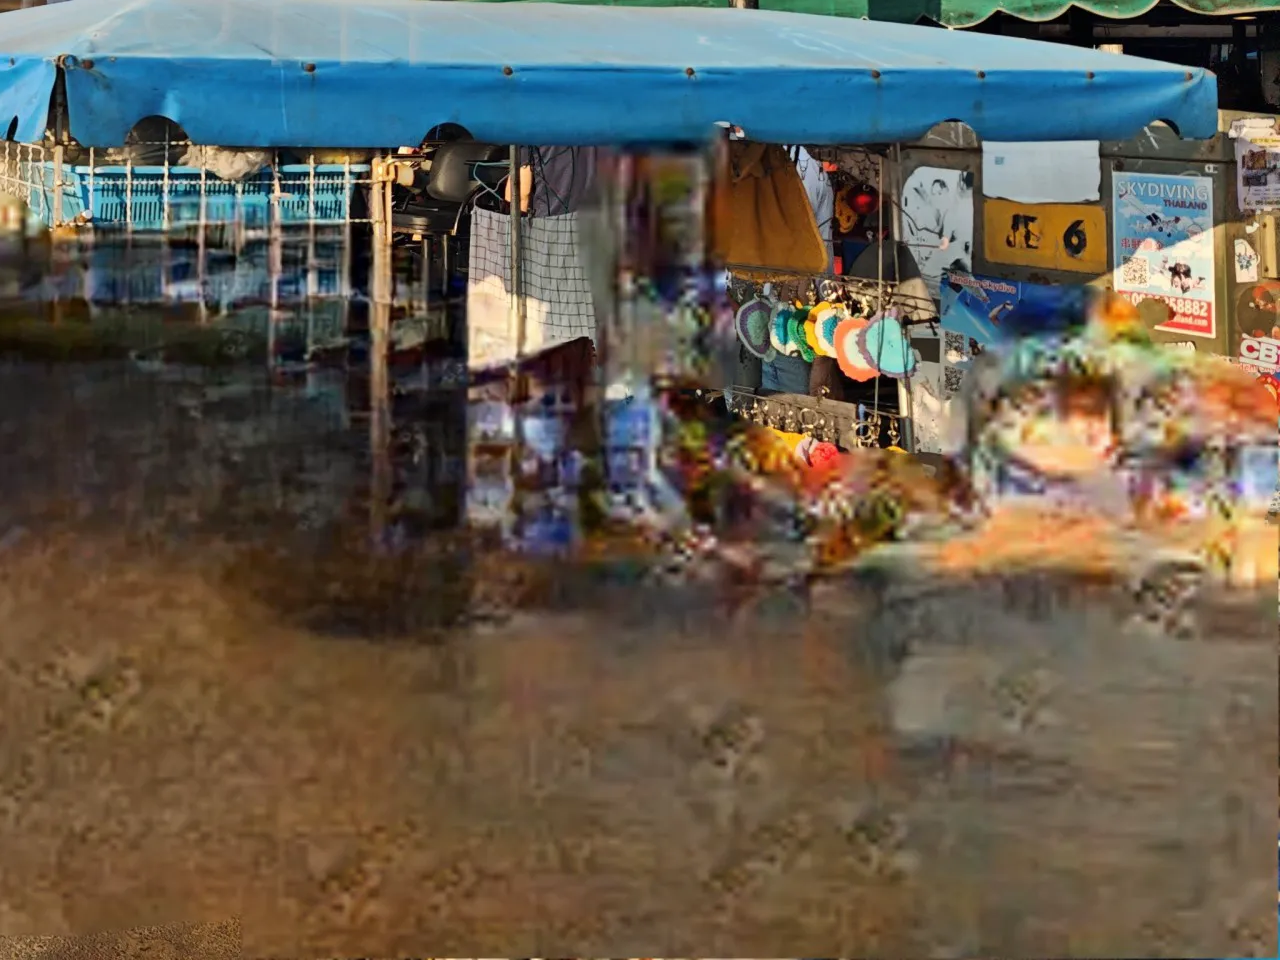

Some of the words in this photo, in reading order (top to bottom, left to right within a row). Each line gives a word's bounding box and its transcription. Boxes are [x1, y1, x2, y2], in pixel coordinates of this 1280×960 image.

[1117, 181, 1208, 201] SKYDIVING
[1163, 199, 1208, 210] THAILAND
[1063, 219, 1087, 257] 6
